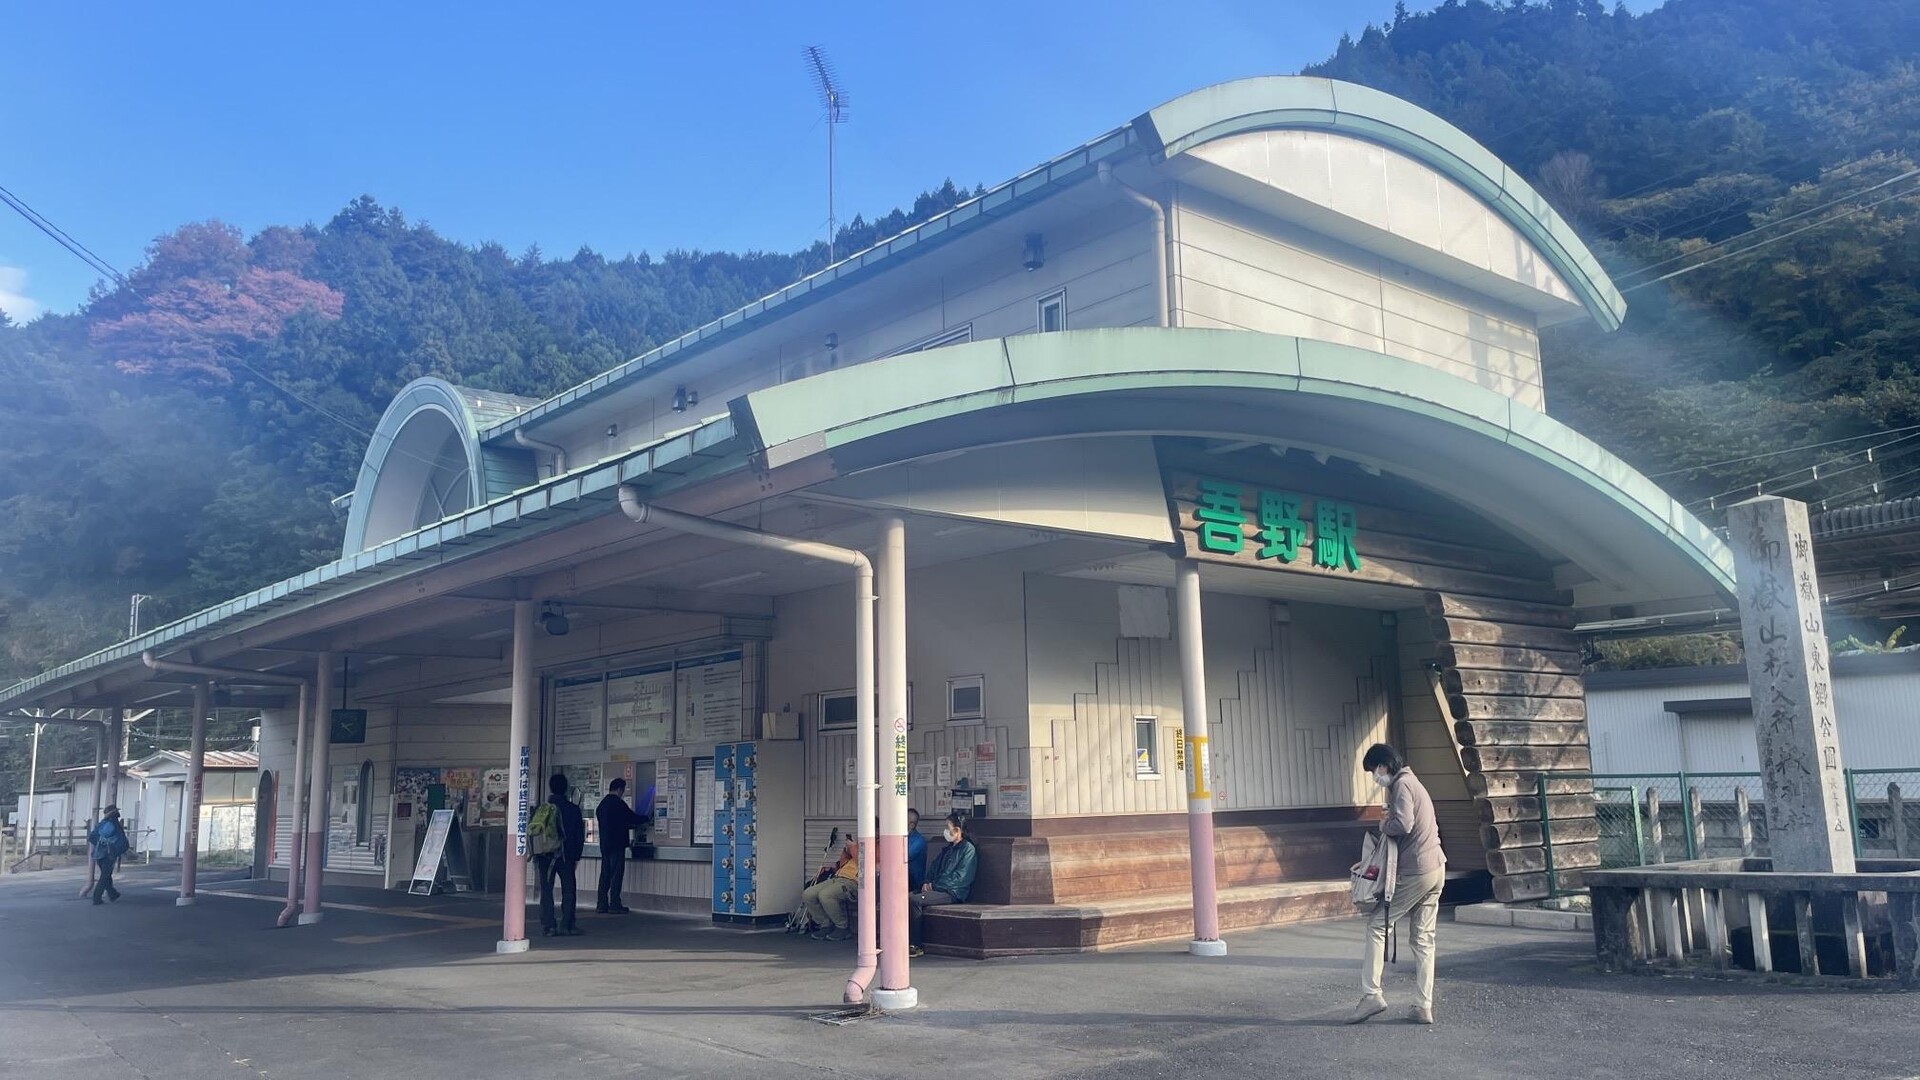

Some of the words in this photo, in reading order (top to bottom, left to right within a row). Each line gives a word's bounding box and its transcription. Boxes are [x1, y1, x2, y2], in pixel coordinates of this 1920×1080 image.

[1195, 480, 1362, 572] 吾野駅
[895, 735, 907, 796] 終日禁煙
[1176, 729, 1184, 770] 終日禁煙
[517, 746, 530, 856] 駅構内は終日禁煙です
